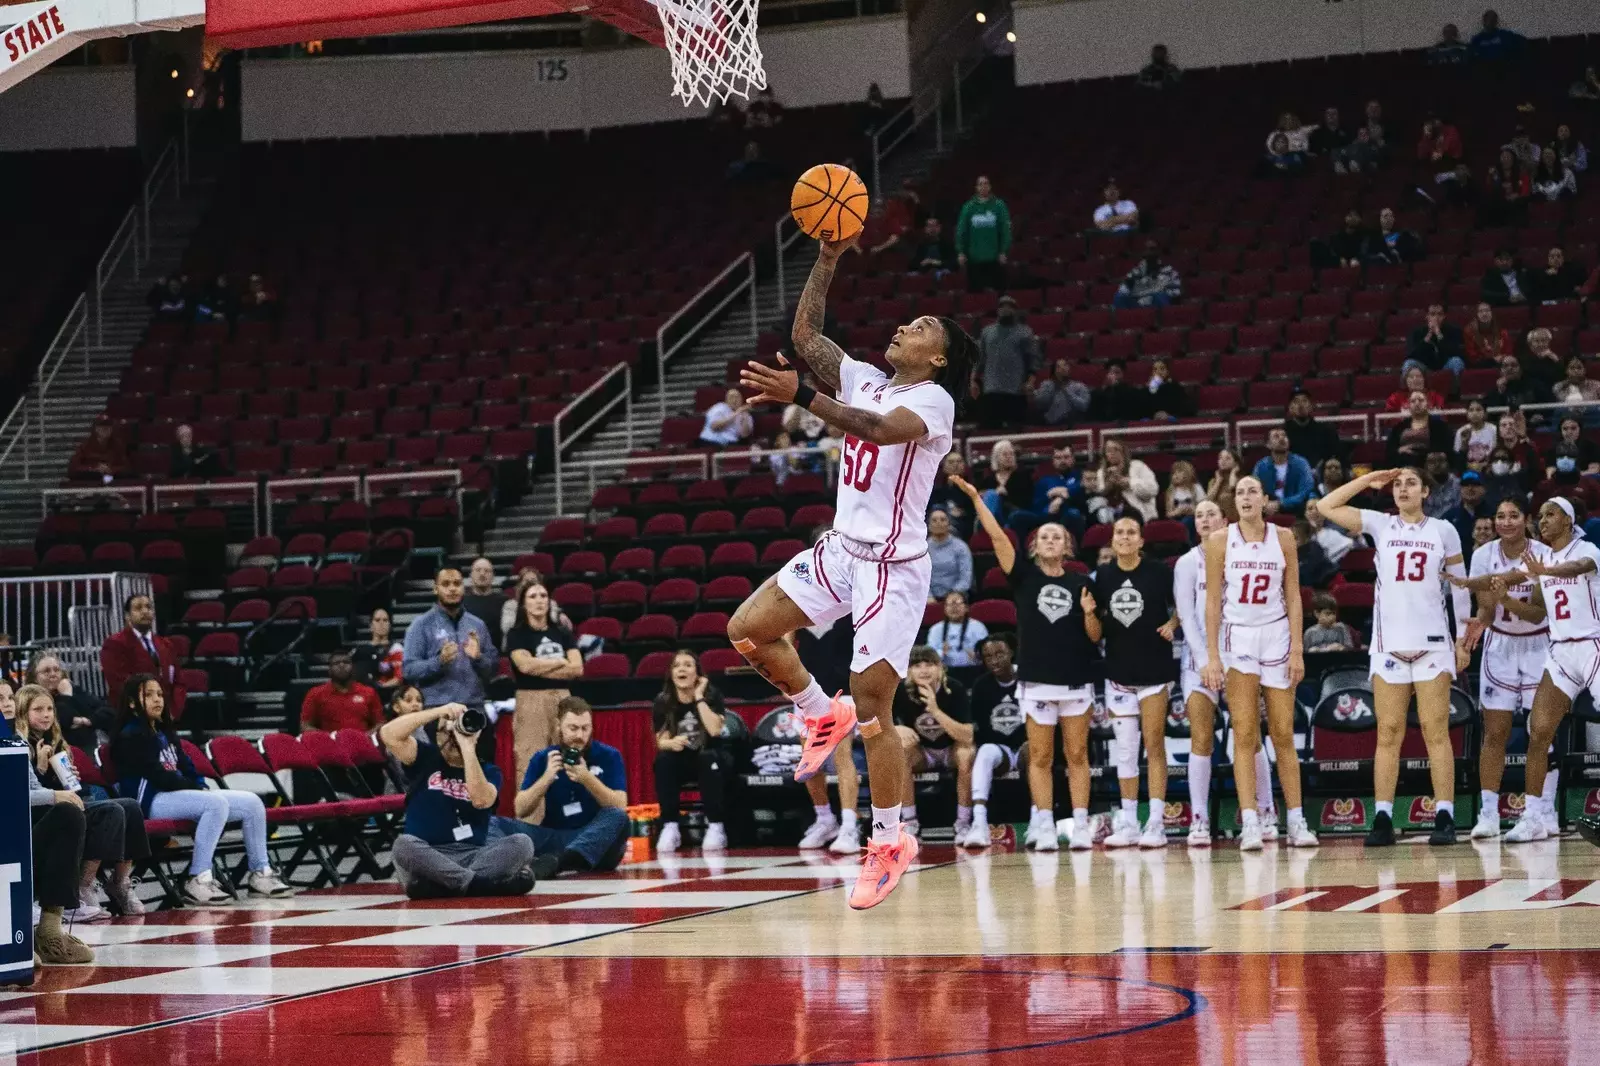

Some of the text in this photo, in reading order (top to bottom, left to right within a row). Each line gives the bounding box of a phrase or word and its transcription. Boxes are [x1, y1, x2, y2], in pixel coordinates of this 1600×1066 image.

[4, 5, 65, 62] STATE
[537, 59, 568, 81] 125
[843, 433, 880, 493] 50
[1387, 539, 1435, 550] FRESNO STATE
[1231, 561, 1278, 570] FRESNO STATE
[1395, 551, 1427, 582] 13
[1238, 573, 1271, 605] 12
[1554, 589, 1570, 620] 2
